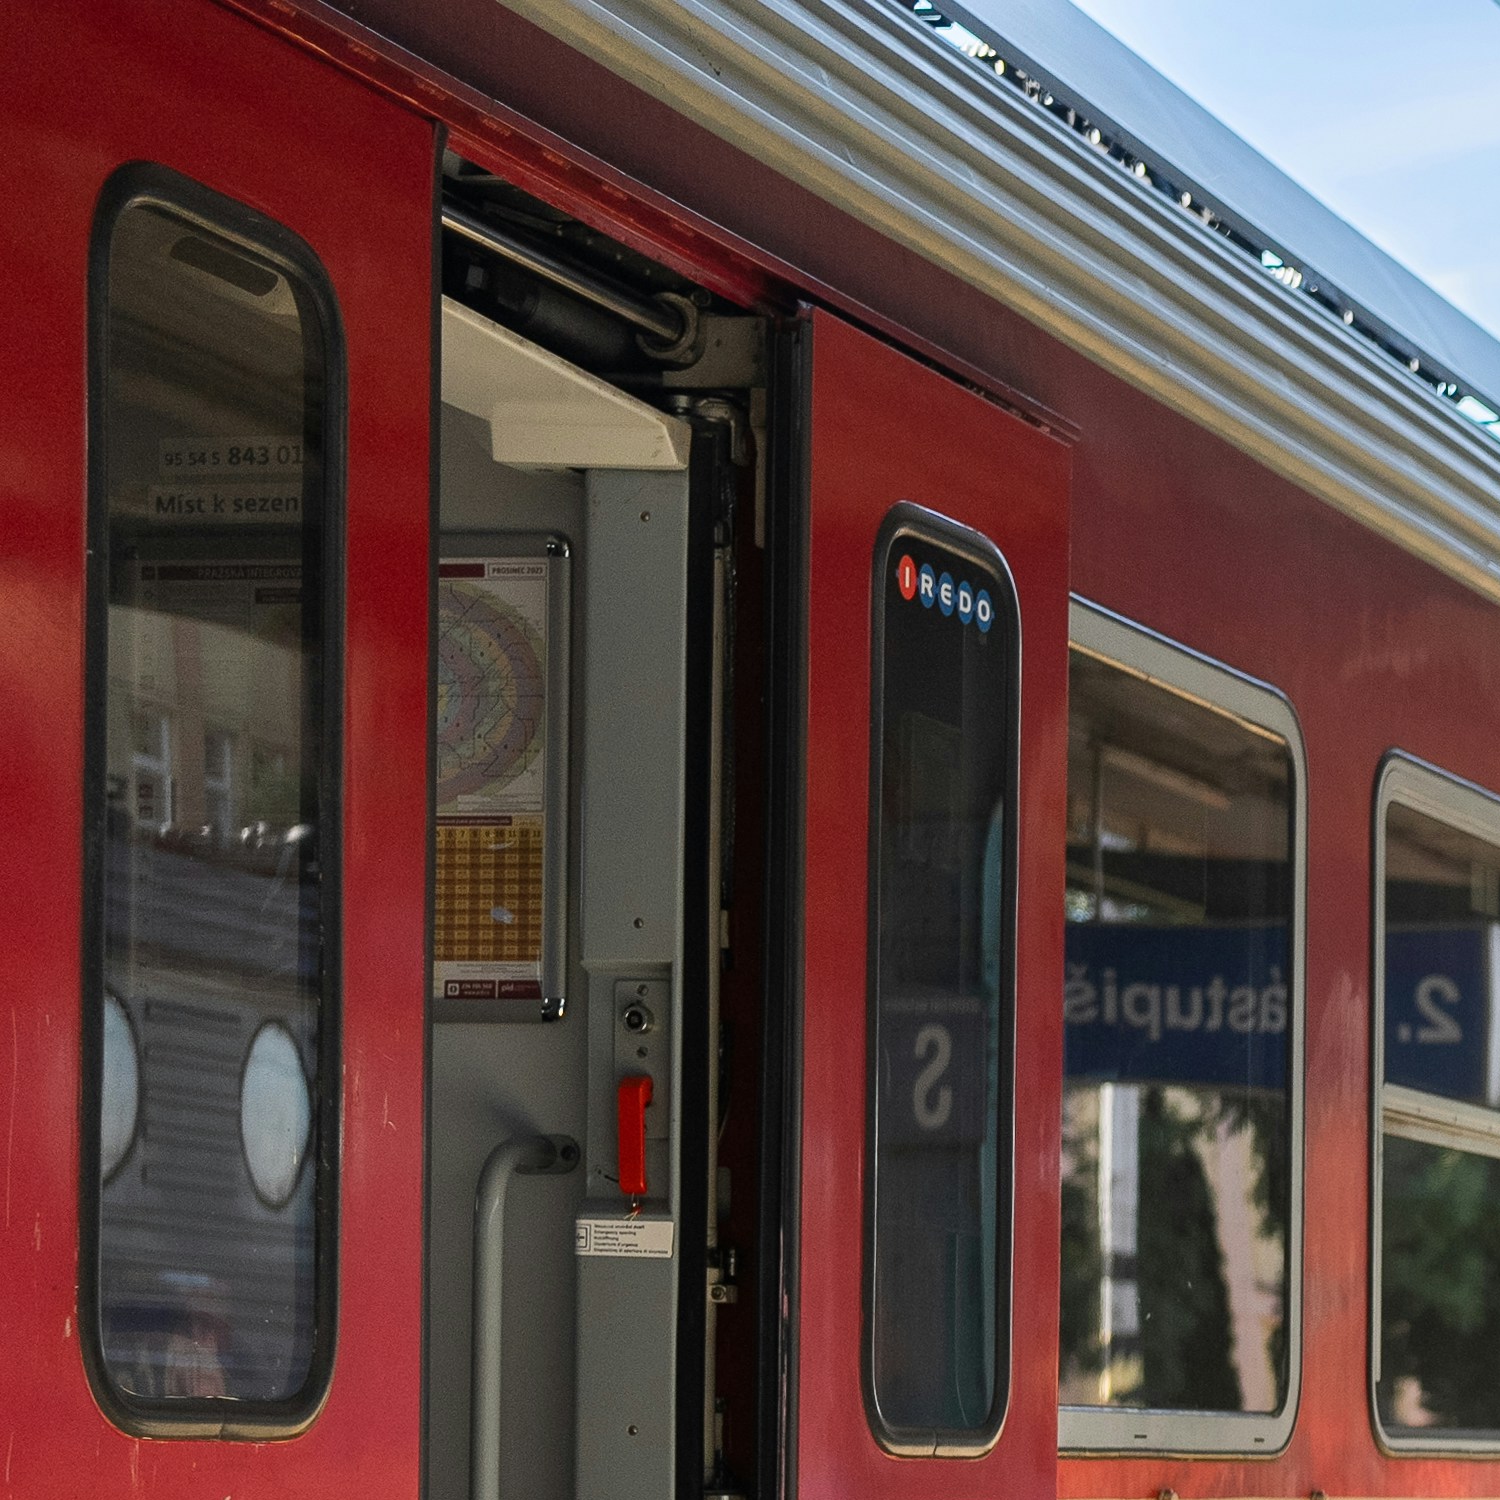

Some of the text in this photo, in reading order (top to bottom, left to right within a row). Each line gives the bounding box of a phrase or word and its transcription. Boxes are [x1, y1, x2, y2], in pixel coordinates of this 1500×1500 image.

[228, 446, 270, 466] 843
[213, 494, 226, 514] k
[904, 565, 991, 623] IREDO
